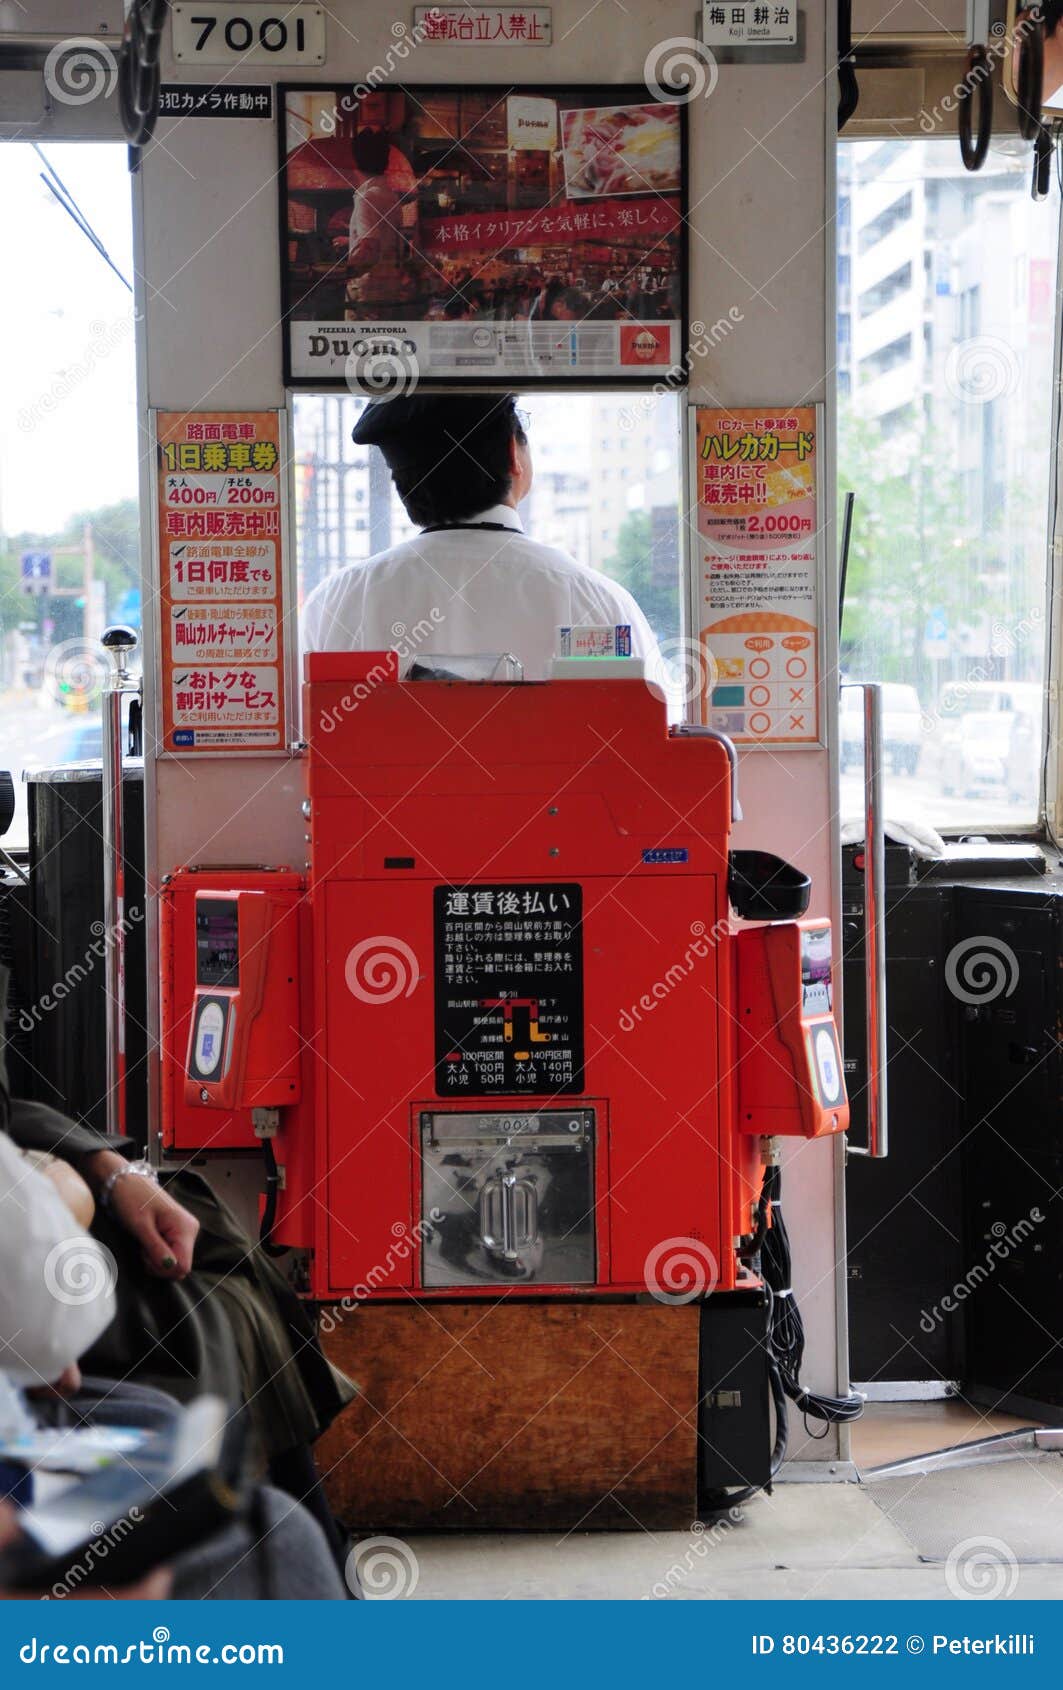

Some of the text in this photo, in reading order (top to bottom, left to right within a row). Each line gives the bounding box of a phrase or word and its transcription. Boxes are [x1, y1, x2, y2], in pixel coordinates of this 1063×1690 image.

[710, 6, 790, 25] 梅田 耕治
[423, 12, 544, 40] 運転台立入禁止
[729, 28, 744, 37] Koji
[190, 17, 305, 52] 7001
[435, 206, 669, 242] 本格イタリアンを気軽に、楽しく。
[308, 335, 417, 357] Duomo
[187, 423, 255, 440] 路面電車
[718, 418, 798, 430] ICカード乗車券
[701, 431, 814, 461] ハレカカード
[164, 441, 279, 472] 1日乗車券
[703, 464, 767, 480] 車内にて
[168, 478, 188, 487] 大人
[227, 477, 253, 487] 子ども
[168, 488, 217, 504] 400円
[227, 488, 275, 504] 200円
[747, 515, 812, 533] 2,000円
[174, 560, 272, 583] 1日何度でも
[175, 622, 275, 646] 岡山カルチャーゾーン
[189, 670, 257, 689] おトクな
[175, 691, 276, 710] 割引サービス
[446, 891, 571, 916] 運賃後払い
[445, 921, 572, 932] 百円区間から岡山駅前方面へ
[445, 931, 572, 942] お越しの方は整理券をお取り
[446, 943, 478, 953] 下さい。
[446, 975, 479, 984] 下さい。
[530, 1050, 572, 1060] 140円区間
[447, 1062, 505, 1074] 大人 100円
[515, 1061, 573, 1072] 大人 140円
[447, 1074, 505, 1085] 小児 50円
[515, 1073, 573, 1084] 小児 70円
